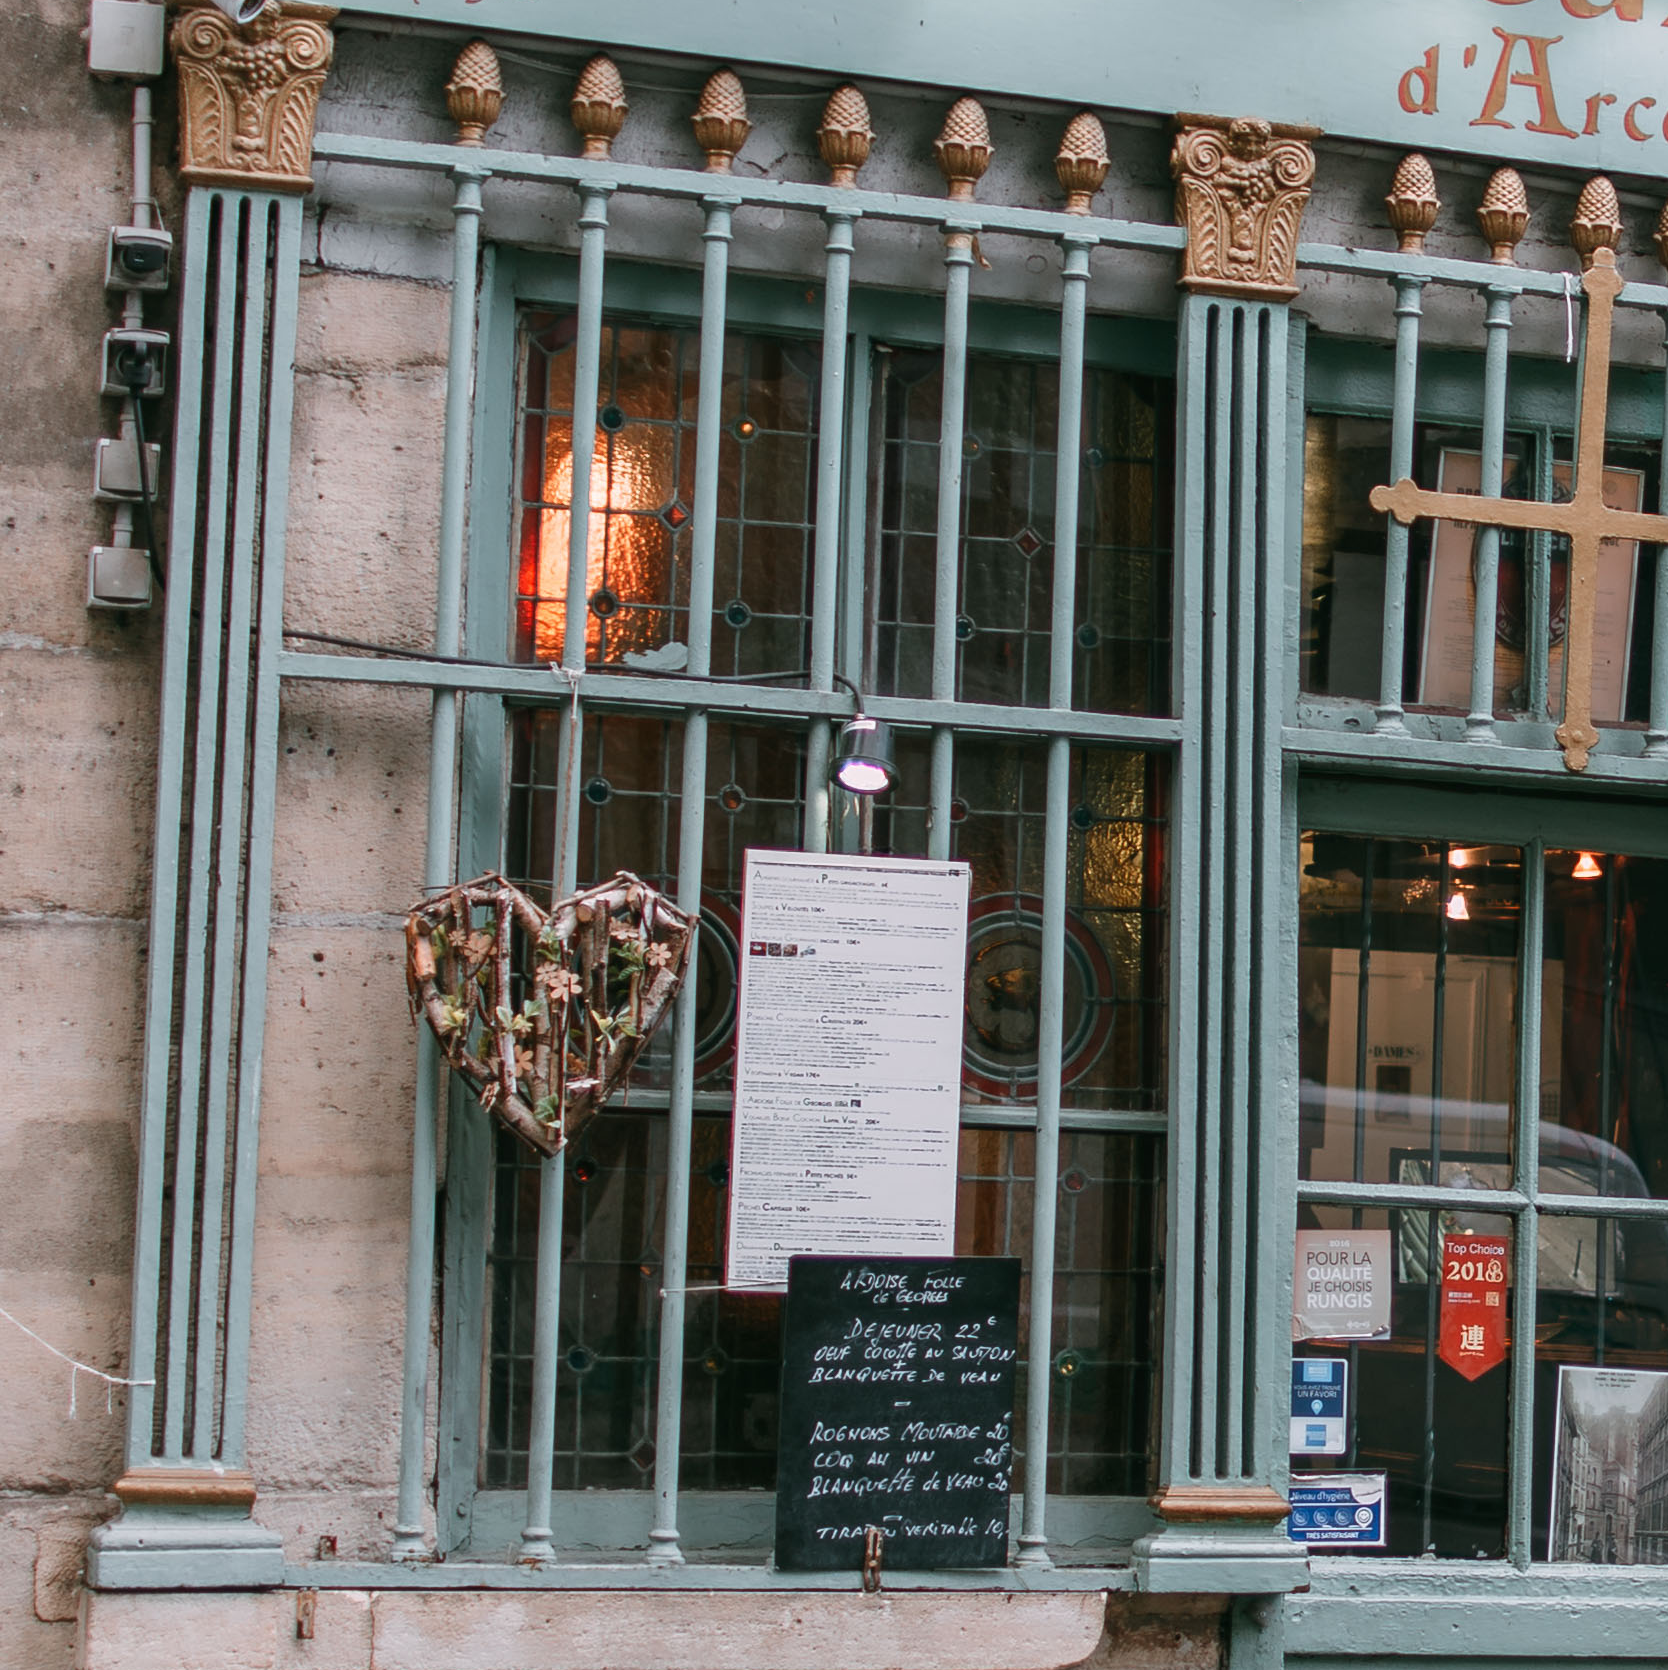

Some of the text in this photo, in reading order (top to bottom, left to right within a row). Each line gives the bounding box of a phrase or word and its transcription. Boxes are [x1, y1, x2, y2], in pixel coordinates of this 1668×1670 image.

[1501, 532, 1569, 551] LICE
[1447, 1242, 1505, 1255] Top Choice
[1306, 1251, 1372, 1265] POUR LA
[1307, 1264, 1372, 1280] QUALITÉ
[1446, 1259, 1503, 1283] 2018
[1307, 1281, 1373, 1293] JE CHOISIS
[1307, 1293, 1372, 1309] RUNGIS
